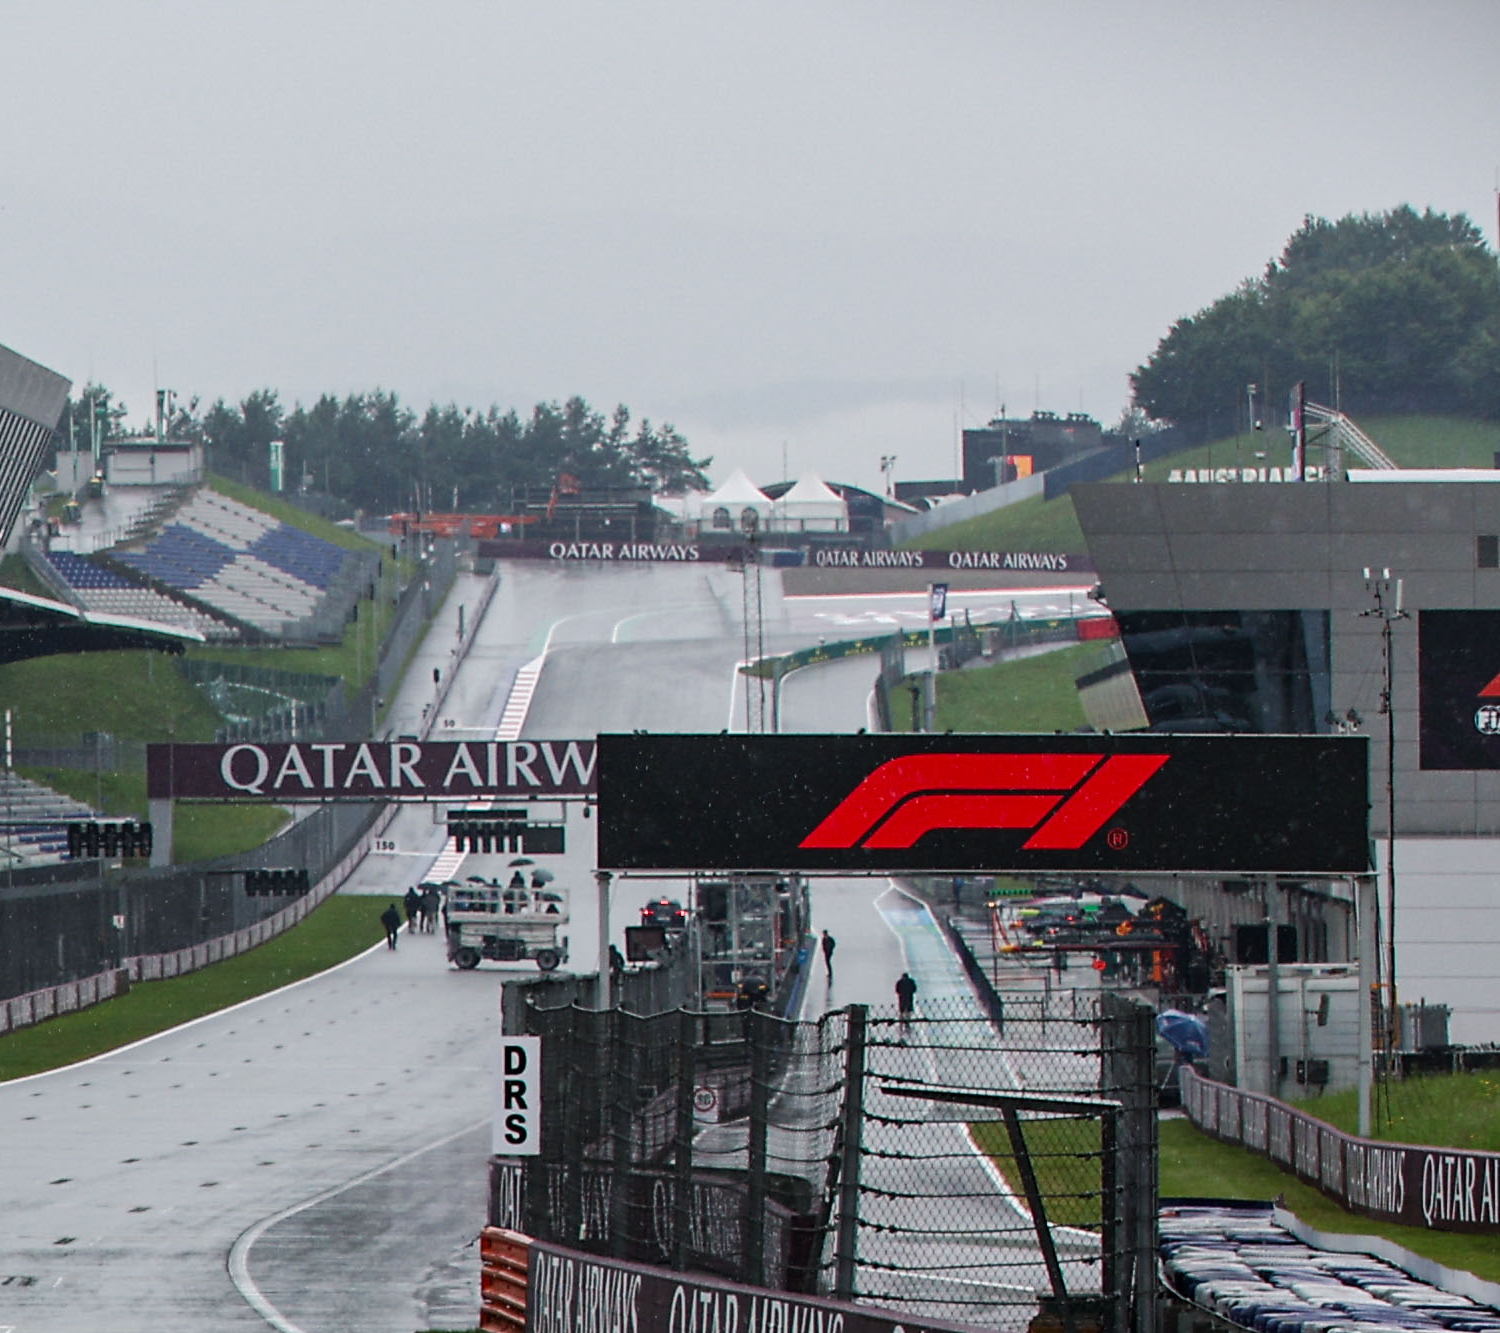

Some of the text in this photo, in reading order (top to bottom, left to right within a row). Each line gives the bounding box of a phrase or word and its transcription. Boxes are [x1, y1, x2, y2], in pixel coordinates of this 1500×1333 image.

[550, 543, 699, 560] QATAR AIRWAYS
[816, 551, 923, 567] QATAR AIRWAYS
[949, 552, 1067, 570] QATAR AIRWAYS
[220, 741, 597, 794] QATAR AIRW
[376, 841, 395, 850] 150
[503, 1045, 528, 1145] DRS
[1422, 1154, 1476, 1226] QATAR
